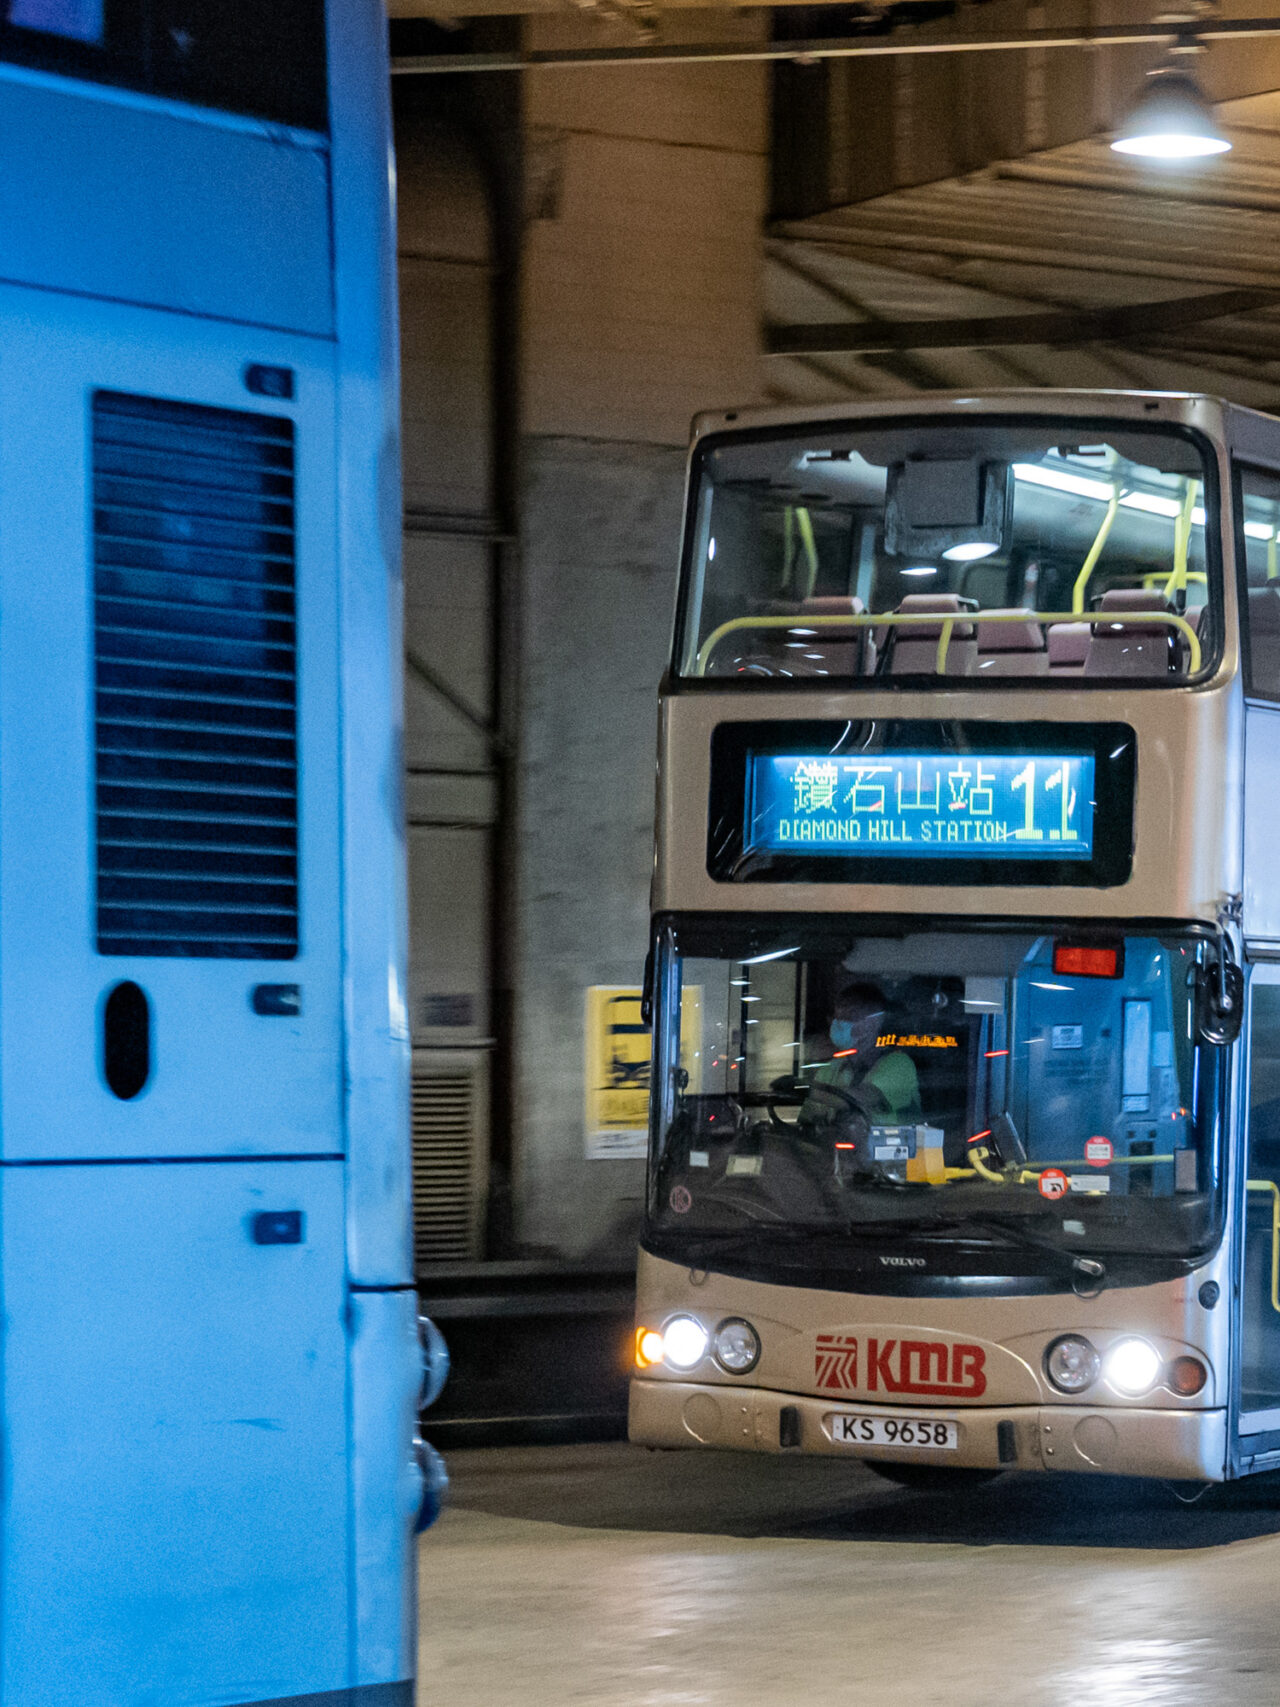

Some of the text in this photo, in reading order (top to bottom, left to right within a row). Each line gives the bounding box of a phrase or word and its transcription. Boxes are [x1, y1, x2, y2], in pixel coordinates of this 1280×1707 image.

[790, 760, 996, 815] 鑽石山站
[1010, 760, 1078, 840] 11
[779, 819, 1007, 842] DIAMOND HILL STATION
[878, 1256, 928, 1267] VOLVO
[842, 1418, 948, 1445] KS 9658
